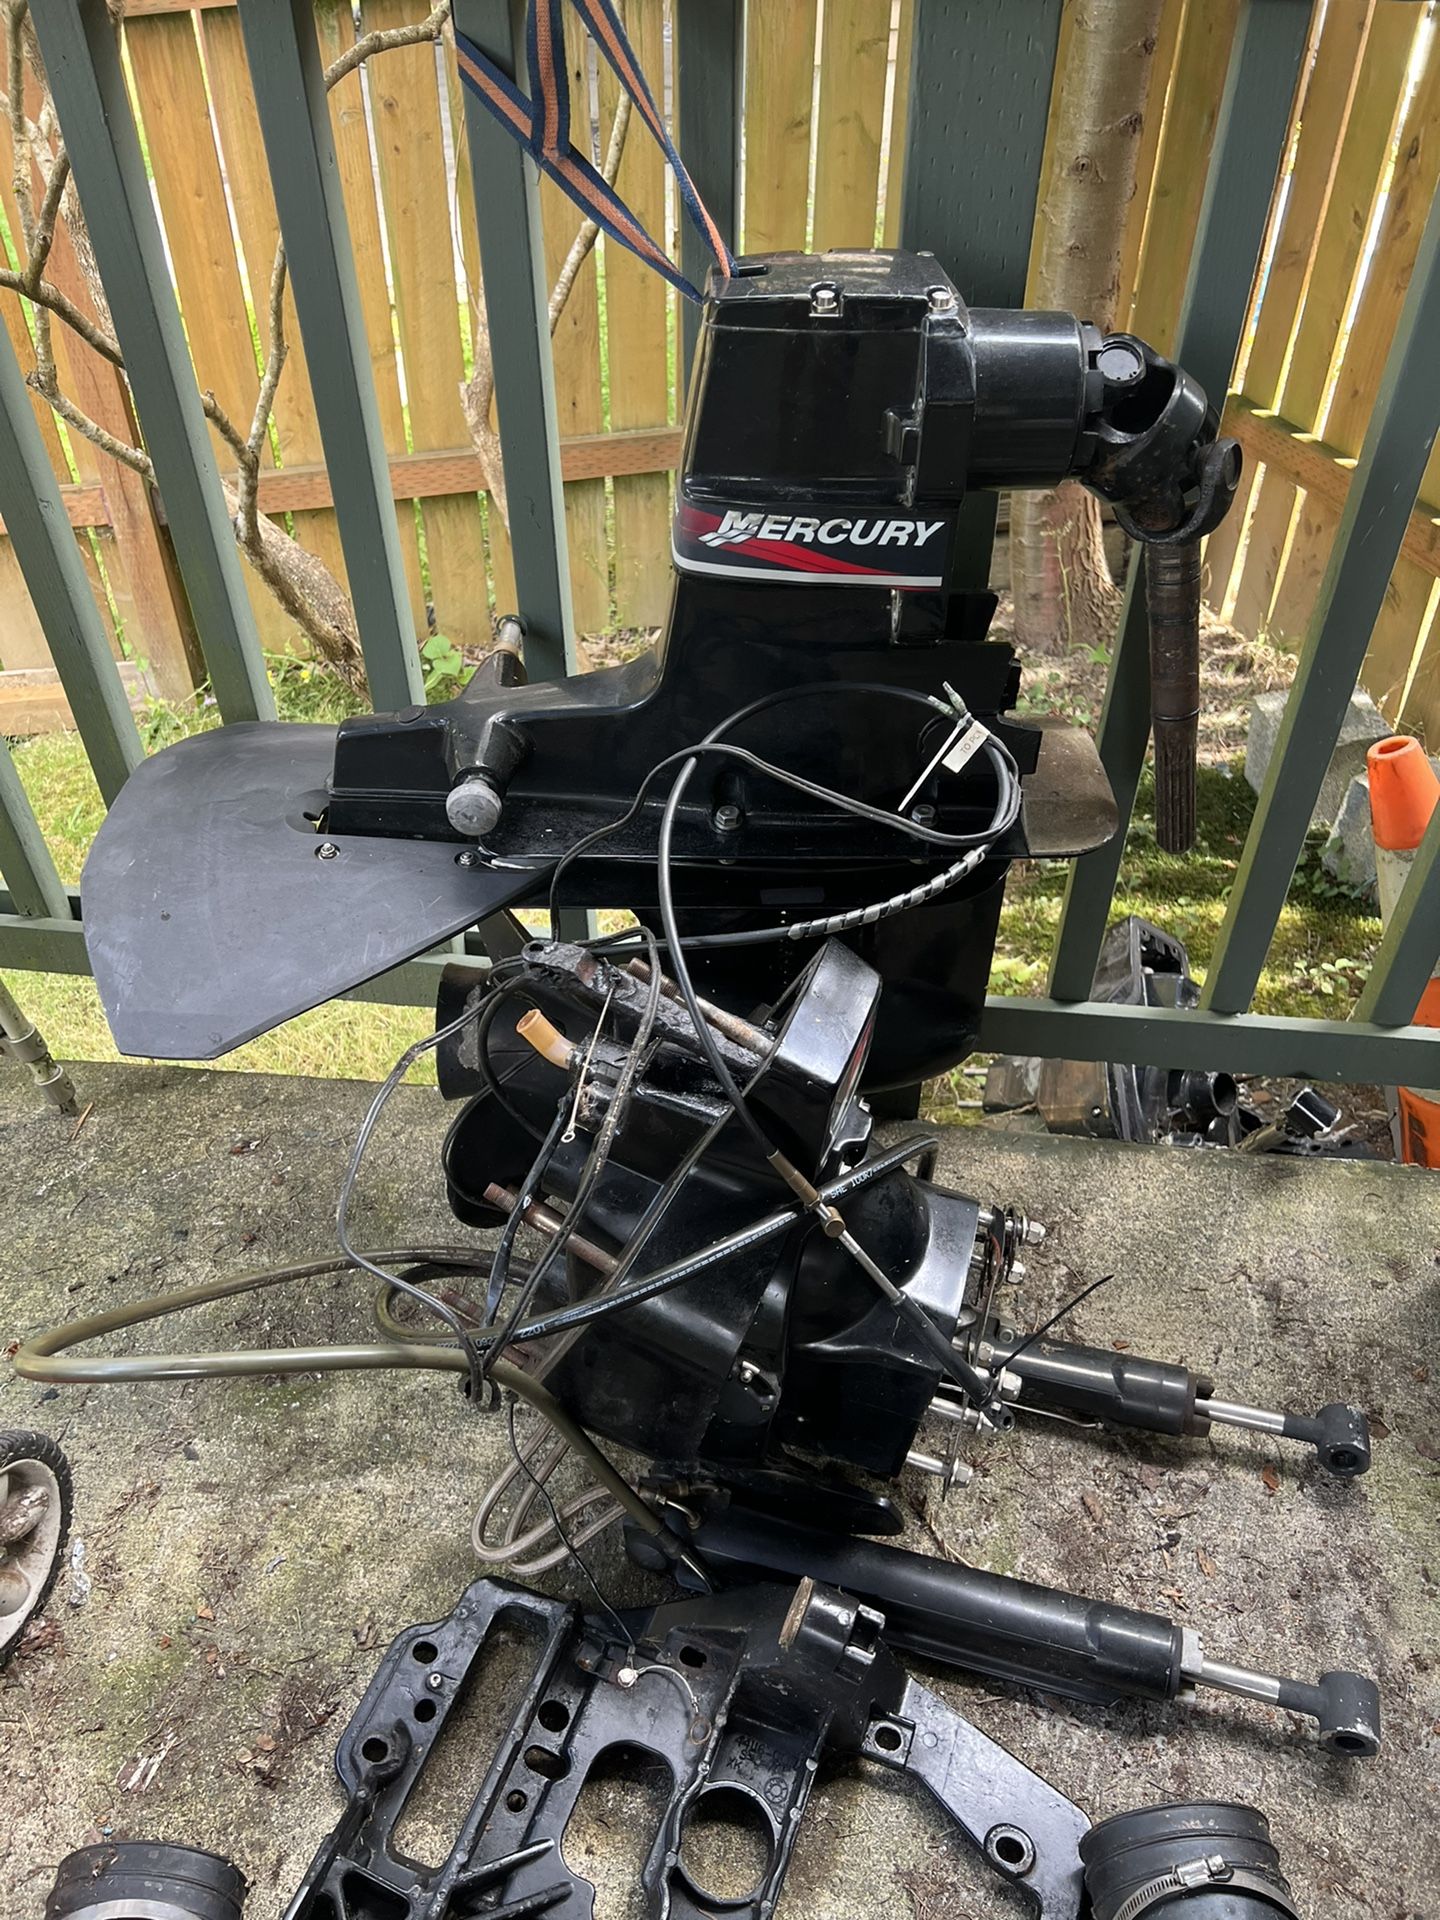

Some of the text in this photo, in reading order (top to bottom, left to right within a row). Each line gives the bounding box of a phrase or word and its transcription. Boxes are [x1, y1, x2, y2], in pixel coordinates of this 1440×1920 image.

[698, 510, 945, 548] MERCURY
[959, 742, 972, 754] TO
[830, 1183, 848, 1199] SAE
